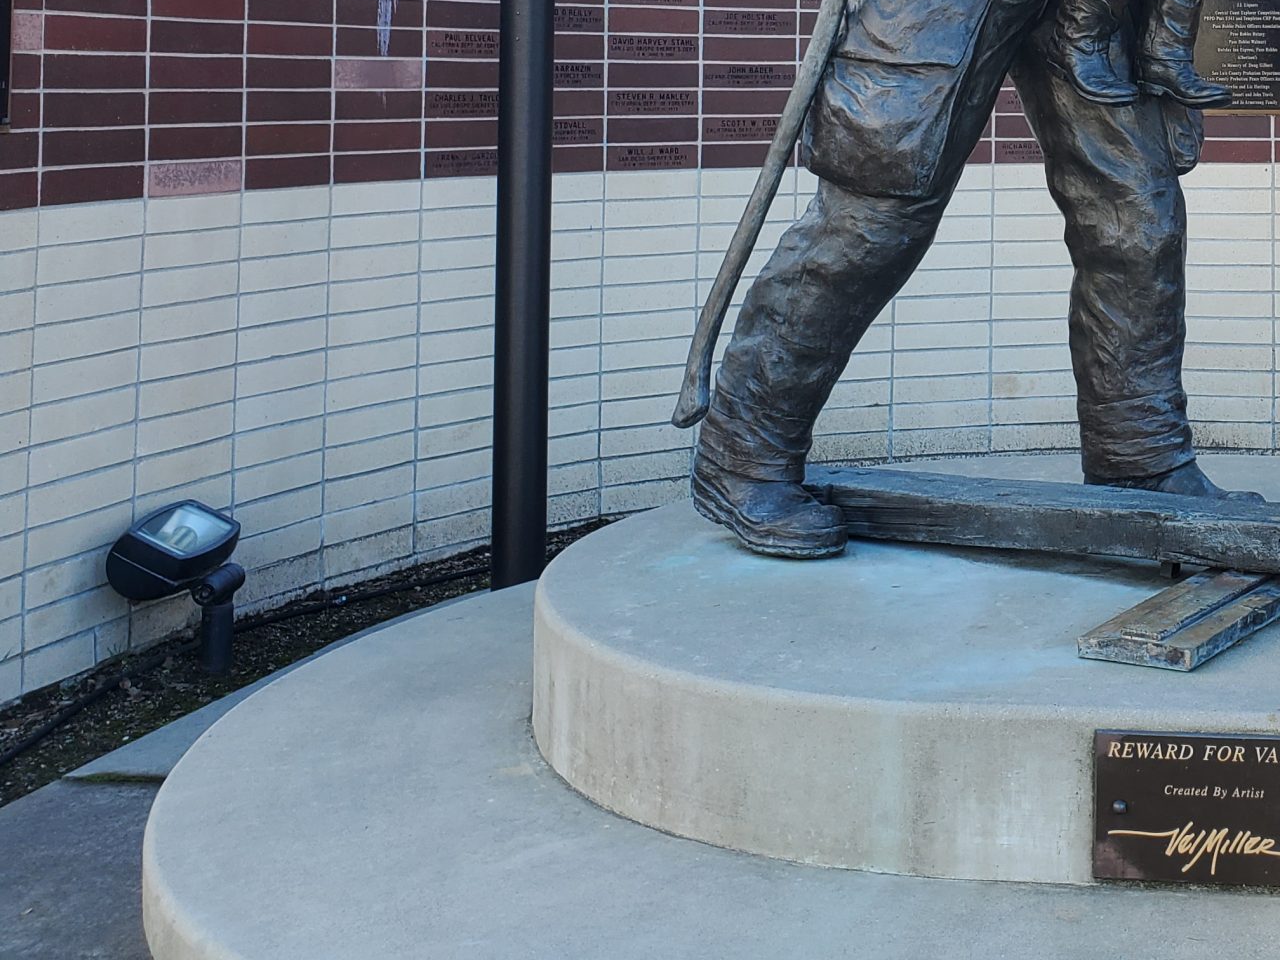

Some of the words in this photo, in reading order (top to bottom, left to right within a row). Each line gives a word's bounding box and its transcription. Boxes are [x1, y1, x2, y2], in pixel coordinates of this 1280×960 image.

[445, 33, 461, 42] PAUL
[613, 37, 638, 45] DAVID
[640, 38, 668, 46] HARVEY
[435, 94, 466, 102] CHARLES
[1108, 742, 1194, 760] REWARD
[1203, 745, 1245, 762] FOR
[1164, 784, 1208, 797] Created
[1213, 786, 1227, 799] By
[1232, 787, 1265, 799] Artist
